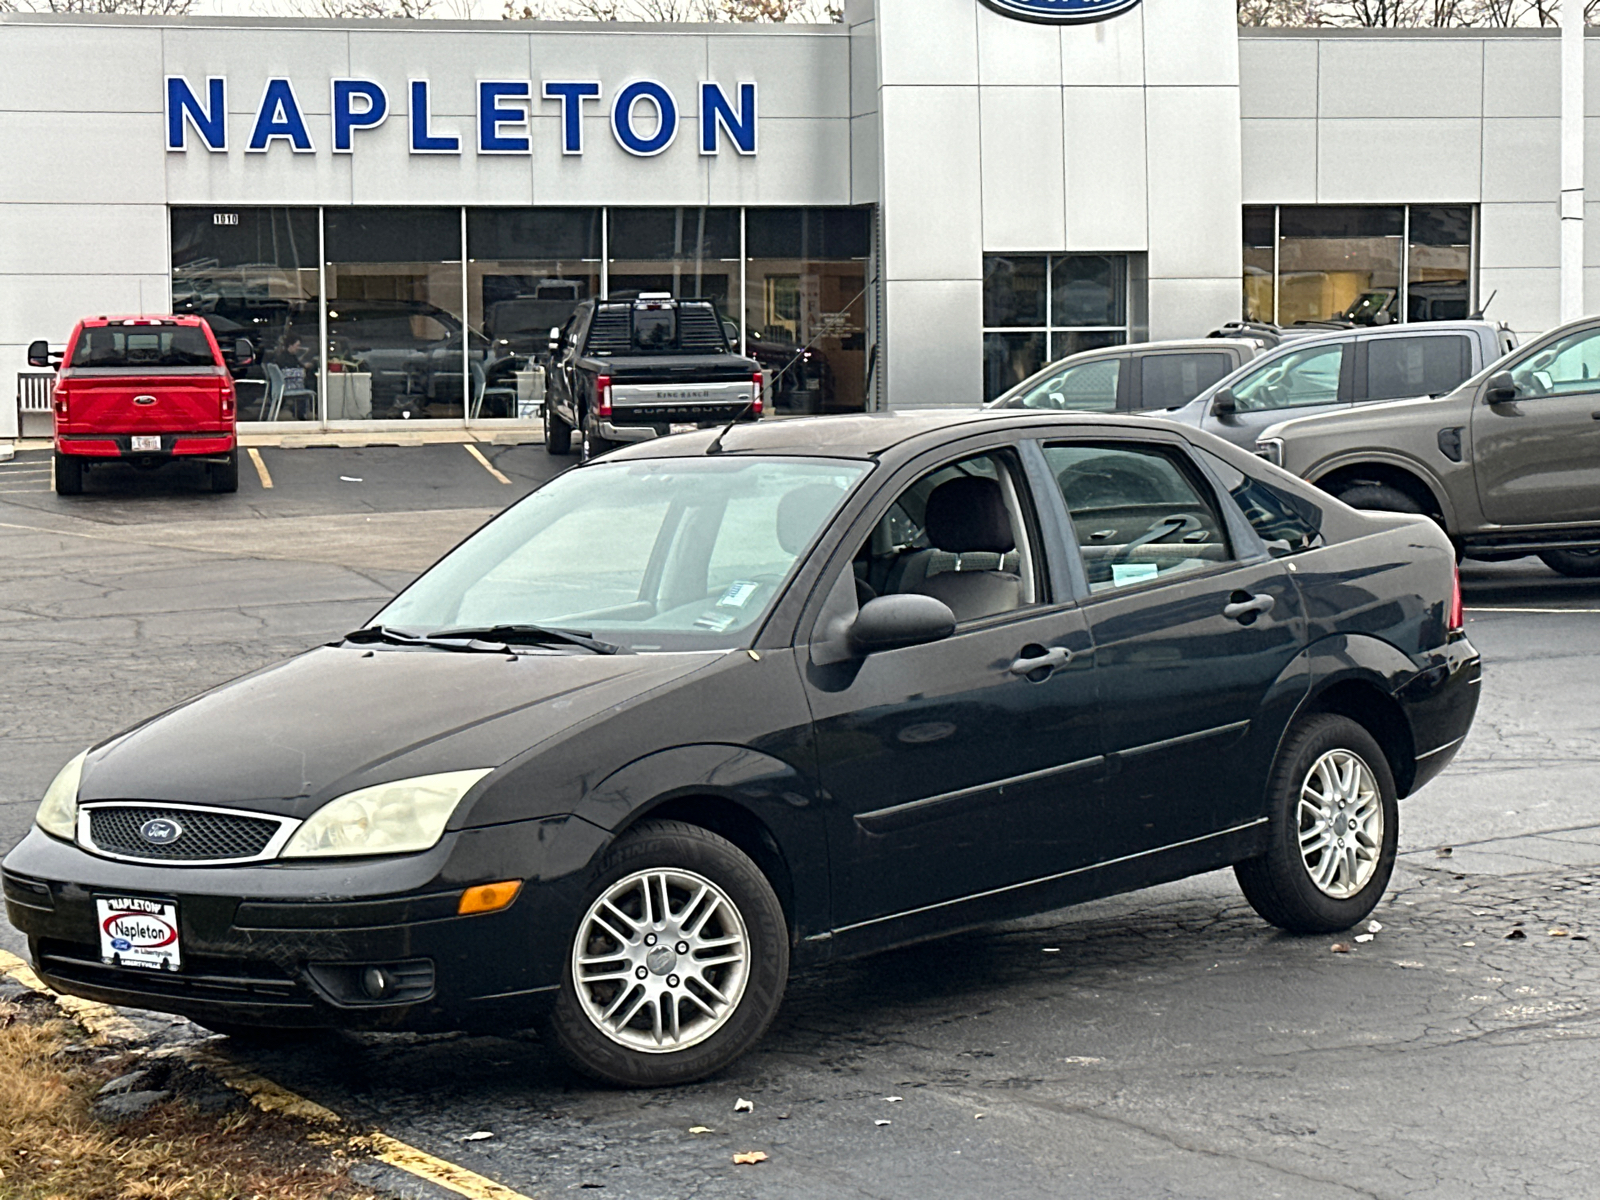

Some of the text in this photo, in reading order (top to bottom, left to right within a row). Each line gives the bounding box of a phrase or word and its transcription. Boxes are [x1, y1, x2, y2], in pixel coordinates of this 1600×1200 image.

[164, 74, 758, 157] NAPLETON
[214, 214, 238, 225] 1010
[148, 823, 170, 838] Ford
[114, 919, 165, 941] Napleton
